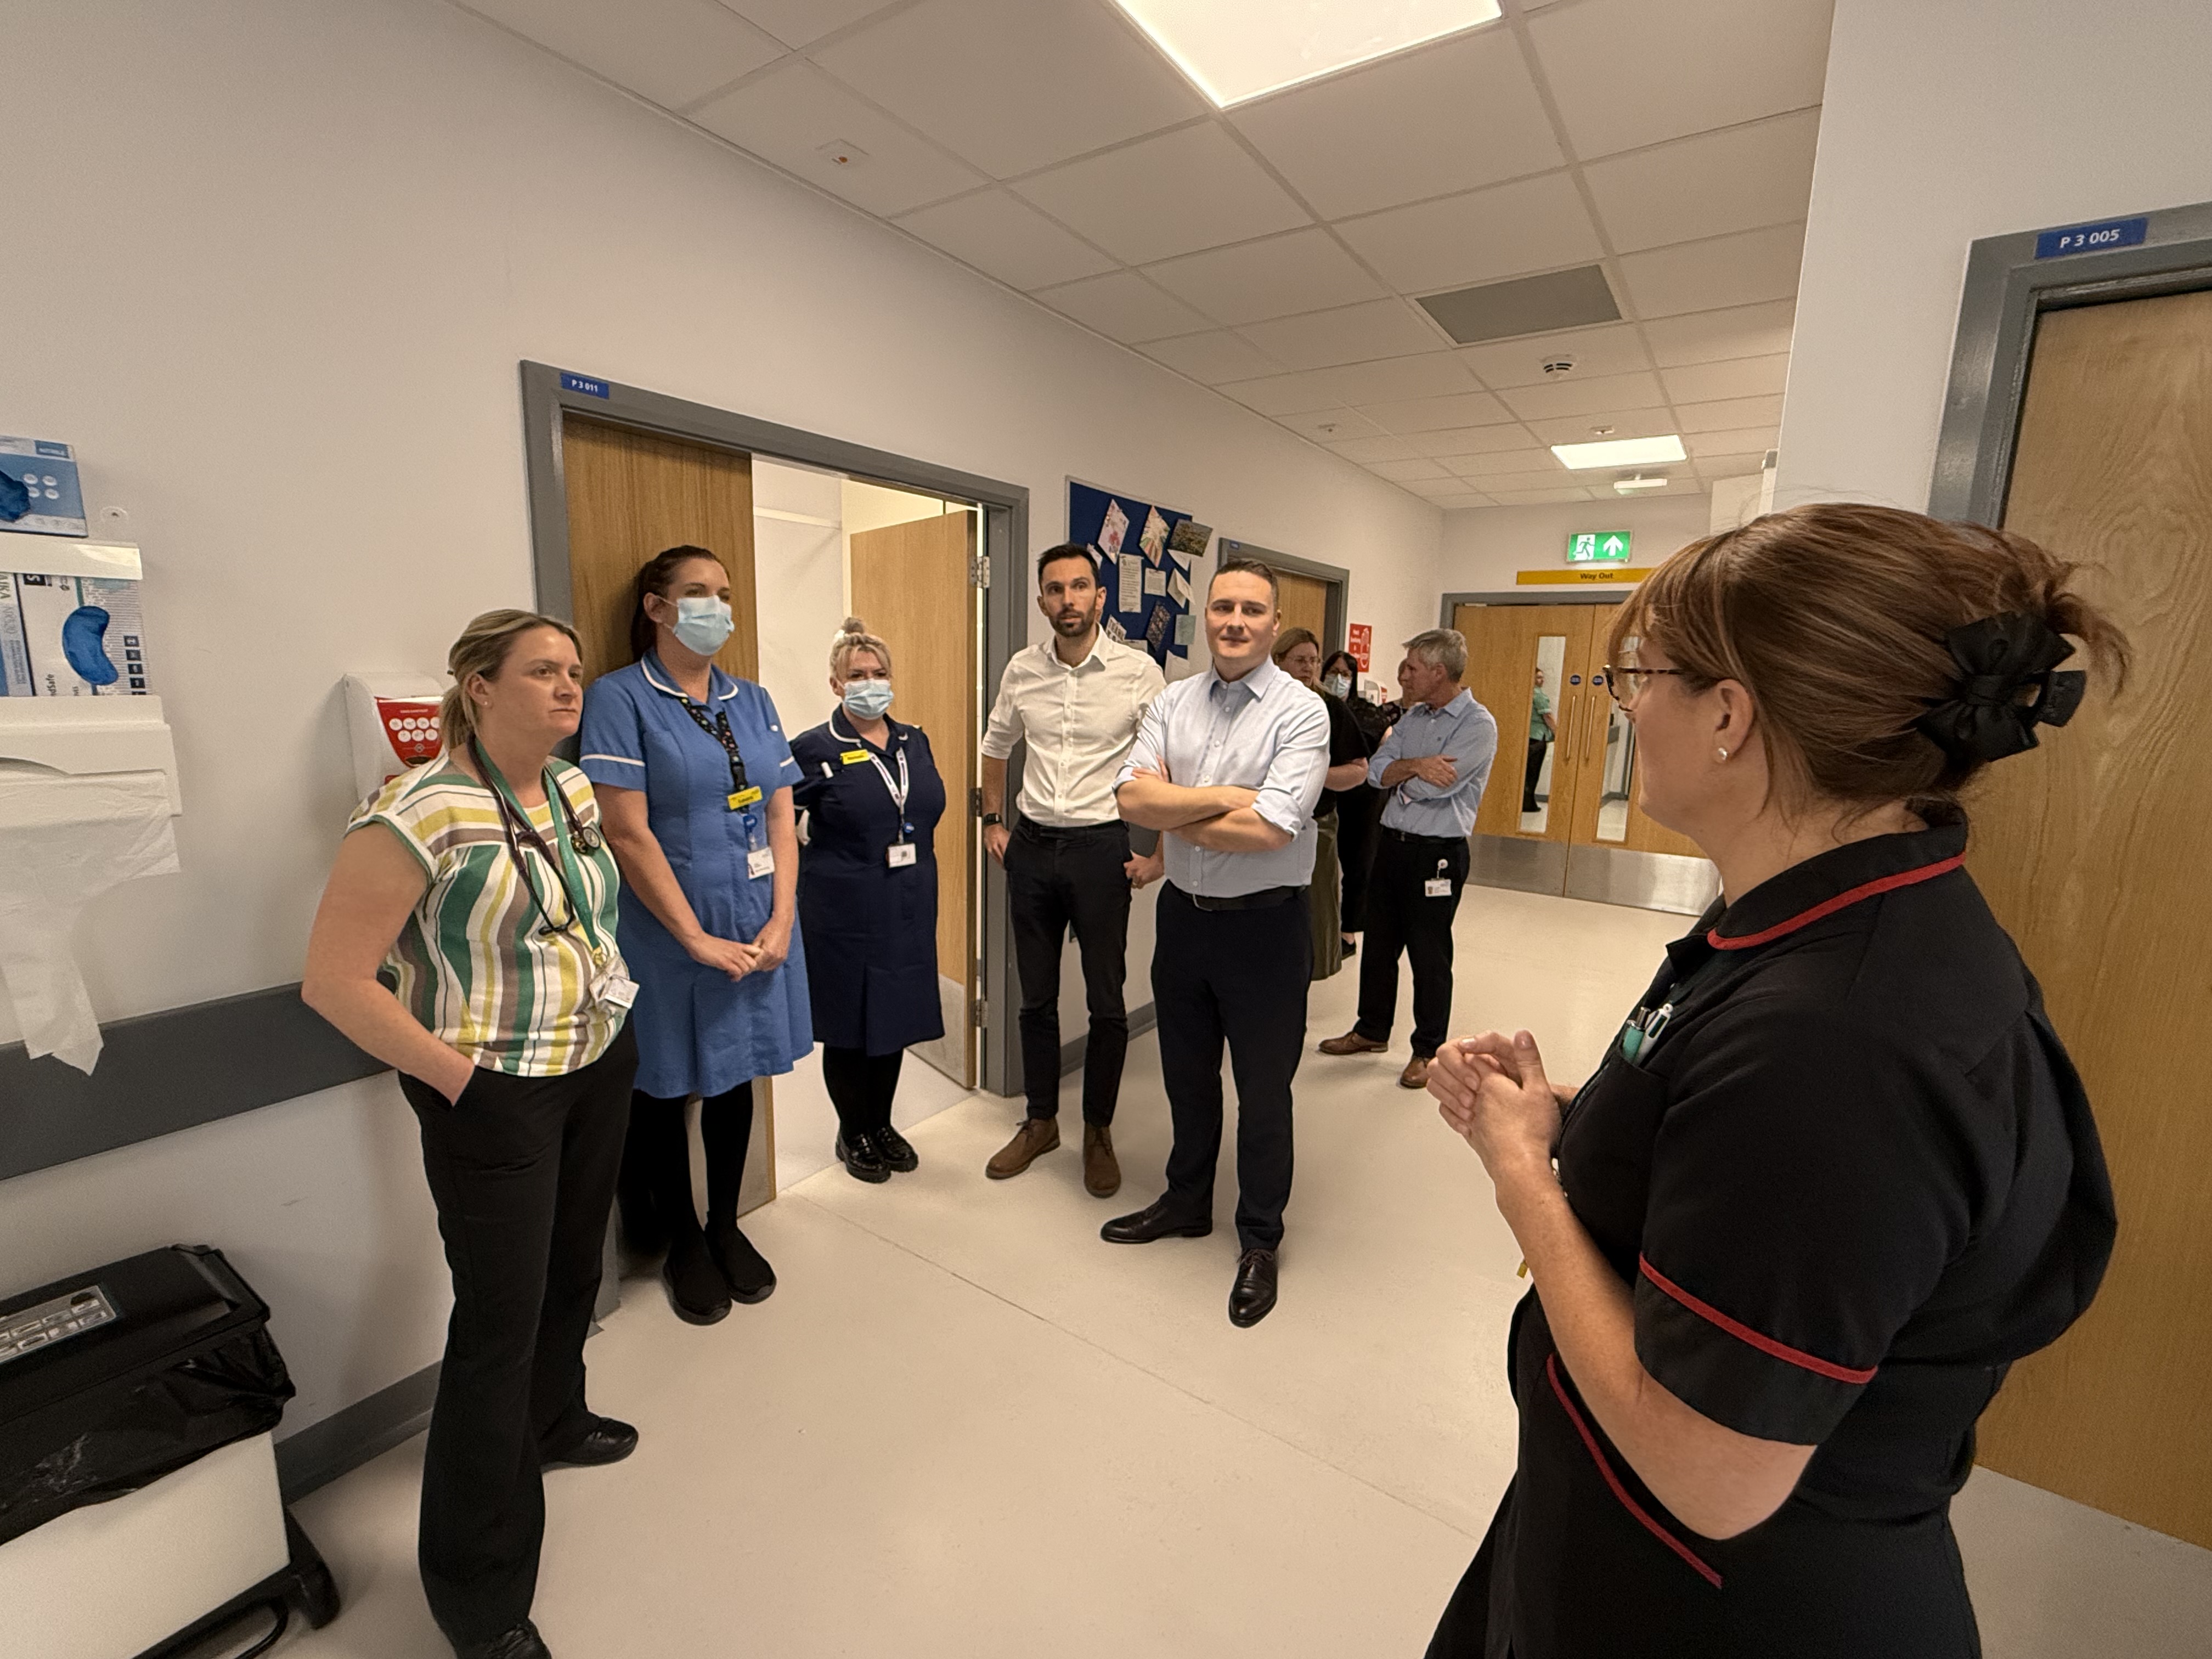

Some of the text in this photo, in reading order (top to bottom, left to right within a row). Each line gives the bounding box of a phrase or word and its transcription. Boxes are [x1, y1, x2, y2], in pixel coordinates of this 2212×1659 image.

[2059, 229, 2120, 248] P 3 005
[585, 382, 598, 393] 011
